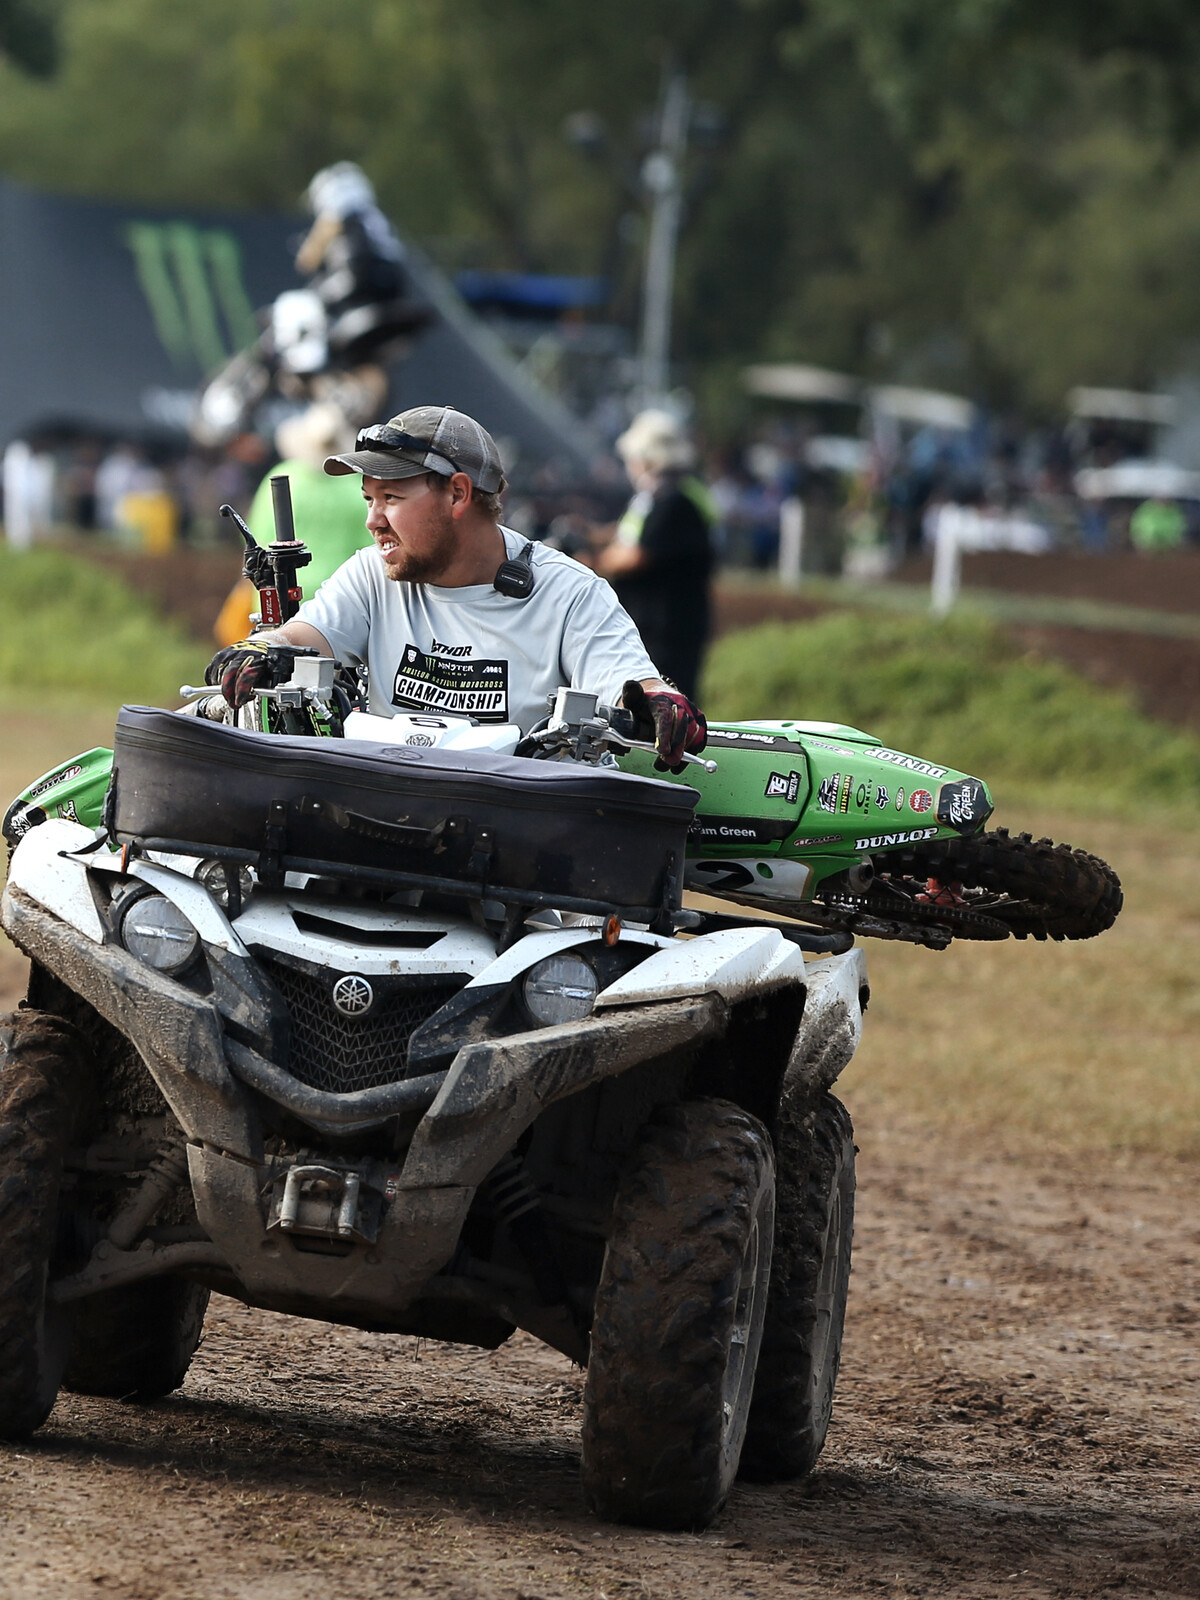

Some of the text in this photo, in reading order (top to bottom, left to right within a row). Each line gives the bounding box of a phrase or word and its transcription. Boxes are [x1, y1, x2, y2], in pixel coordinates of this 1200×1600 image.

[438, 643, 473, 657] THOR
[402, 666, 430, 680] AMATEUR
[397, 678, 503, 709] CHAMPIONSHIP
[864, 748, 947, 778] DUNLOP
[840, 776, 851, 813] HINSON
[864, 779, 872, 814] OAKLEY
[950, 793, 962, 824] TEAM
[961, 785, 974, 820] GREEN
[720, 826, 756, 837] Green
[855, 828, 938, 850] DUNLOP
